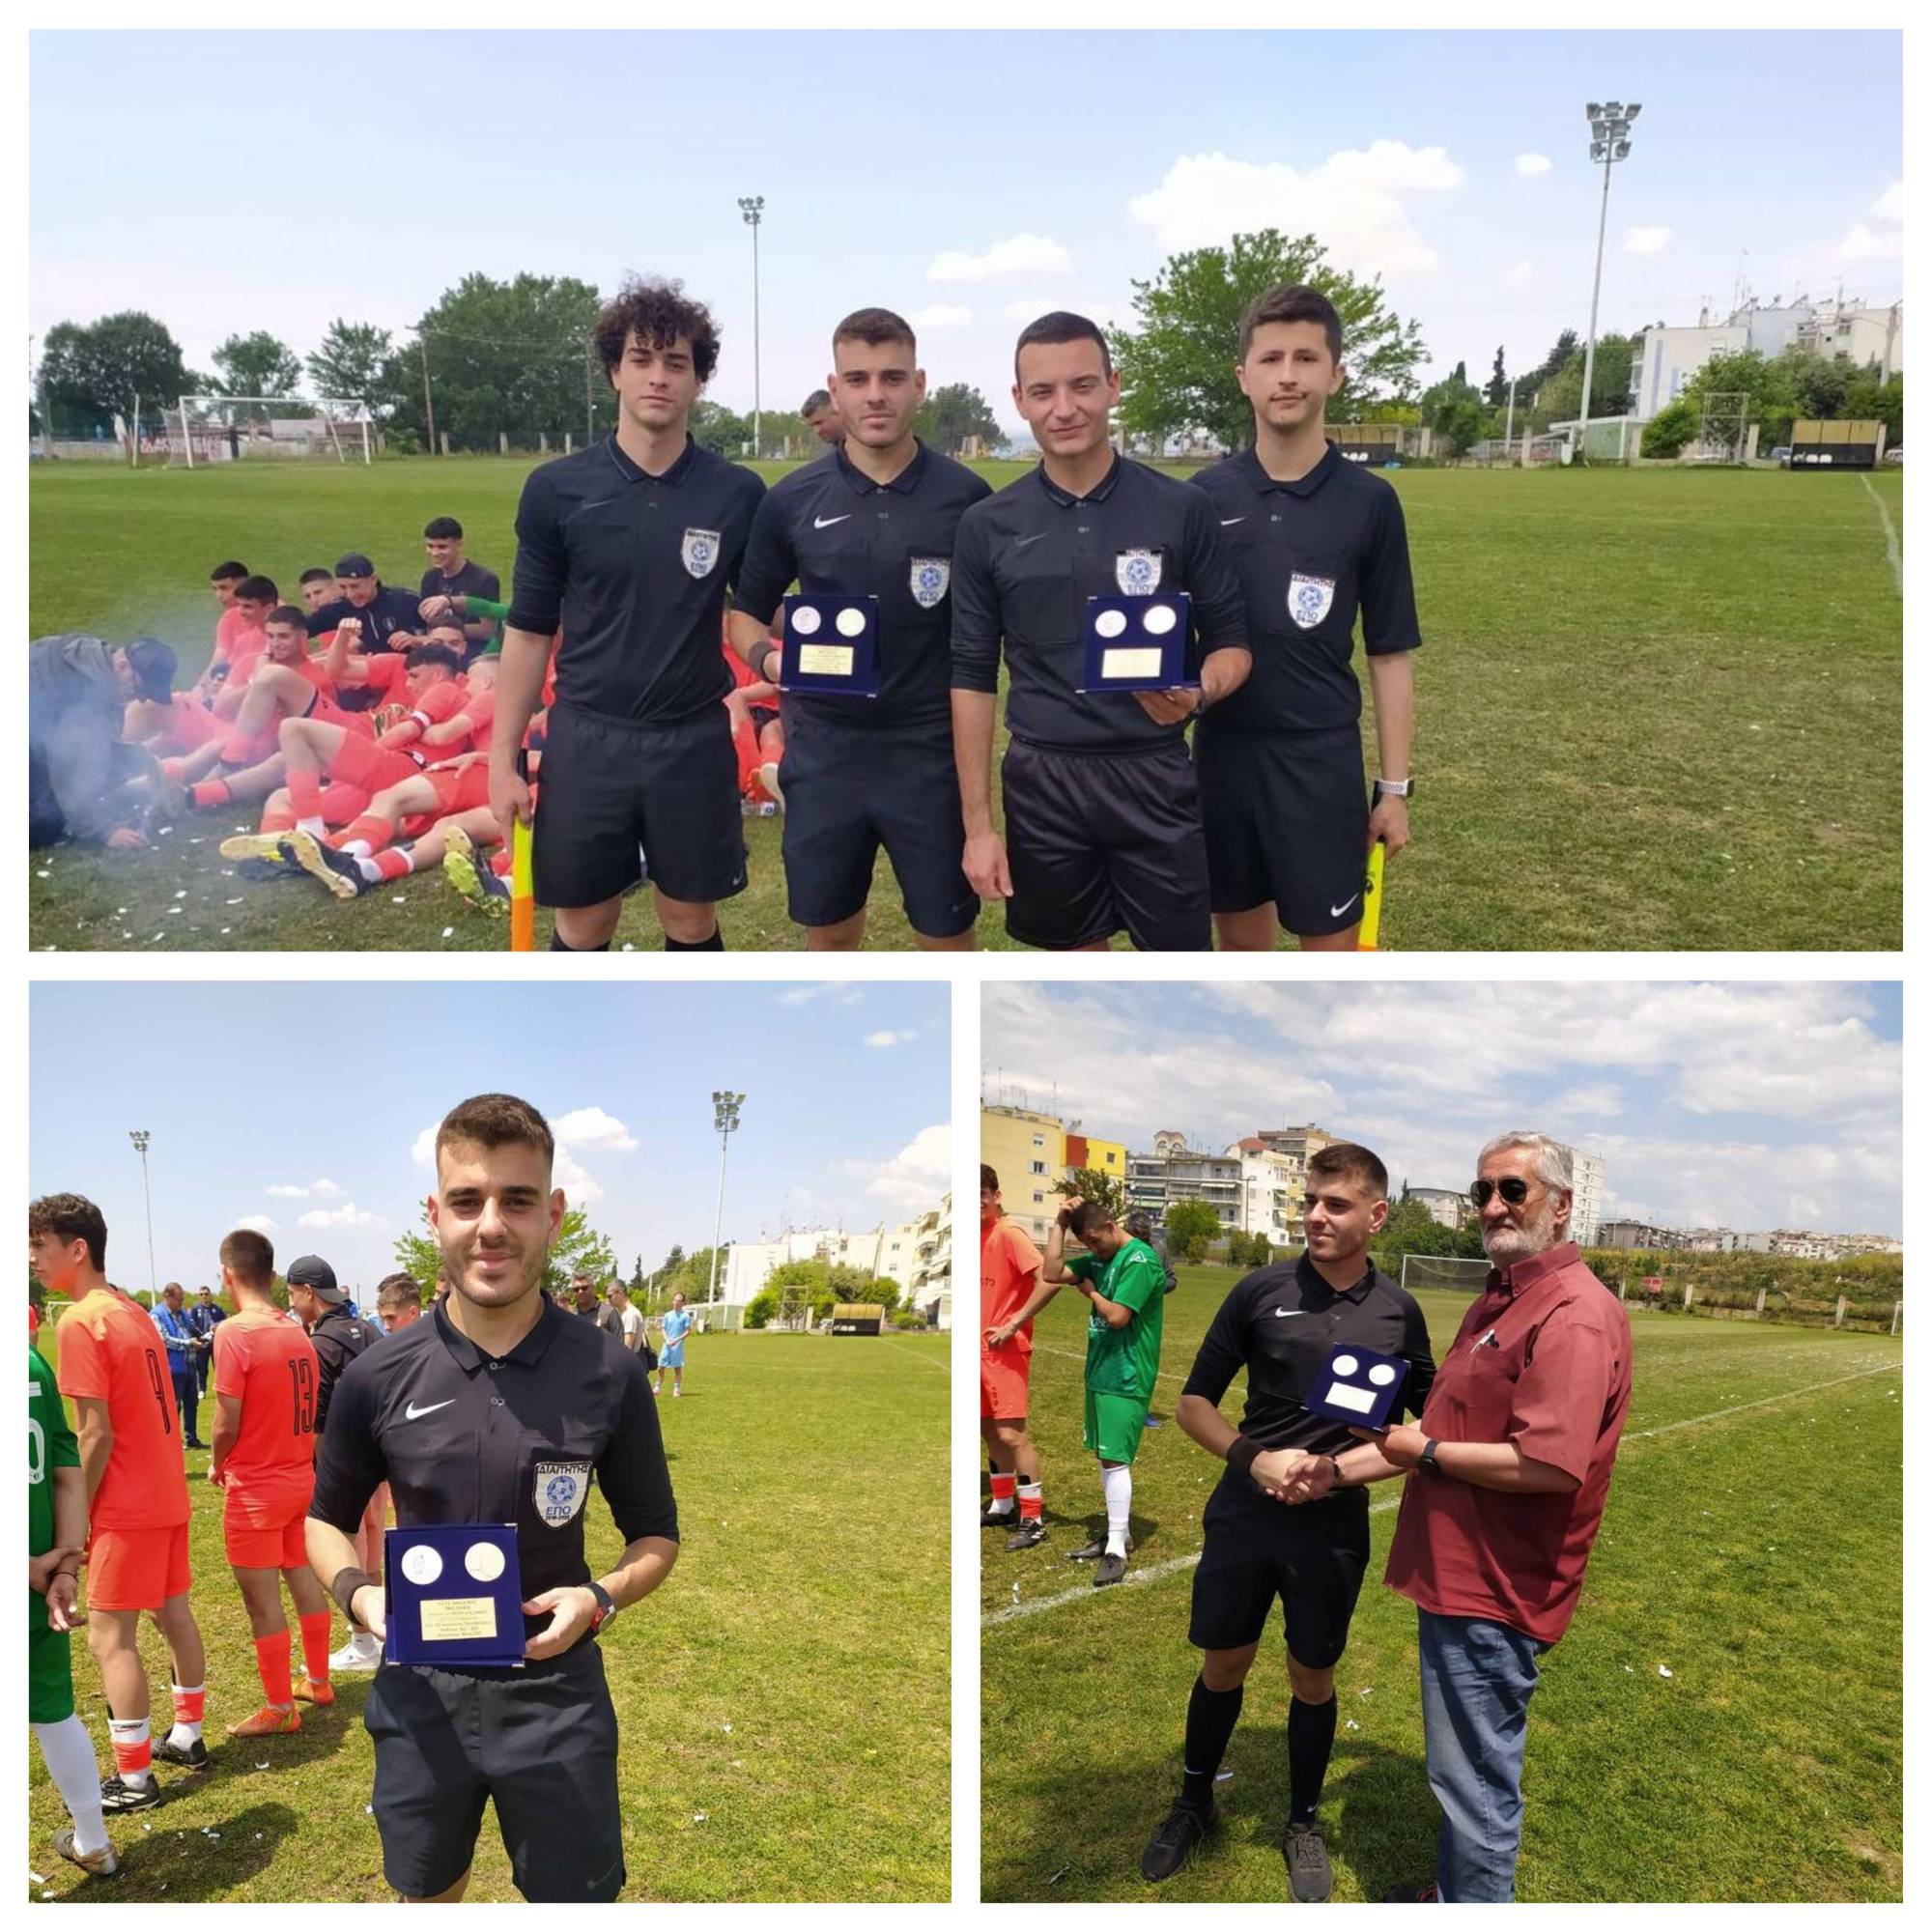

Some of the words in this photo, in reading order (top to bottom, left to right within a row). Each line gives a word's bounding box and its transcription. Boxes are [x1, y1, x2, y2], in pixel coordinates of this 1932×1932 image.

[145, 1348, 171, 1435] 9
[288, 1357, 314, 1436] 13
[537, 1464, 589, 1474] ΔΙΑΙΤΗΤΗΣ
[546, 1505, 571, 1516] ΕΠΟ
